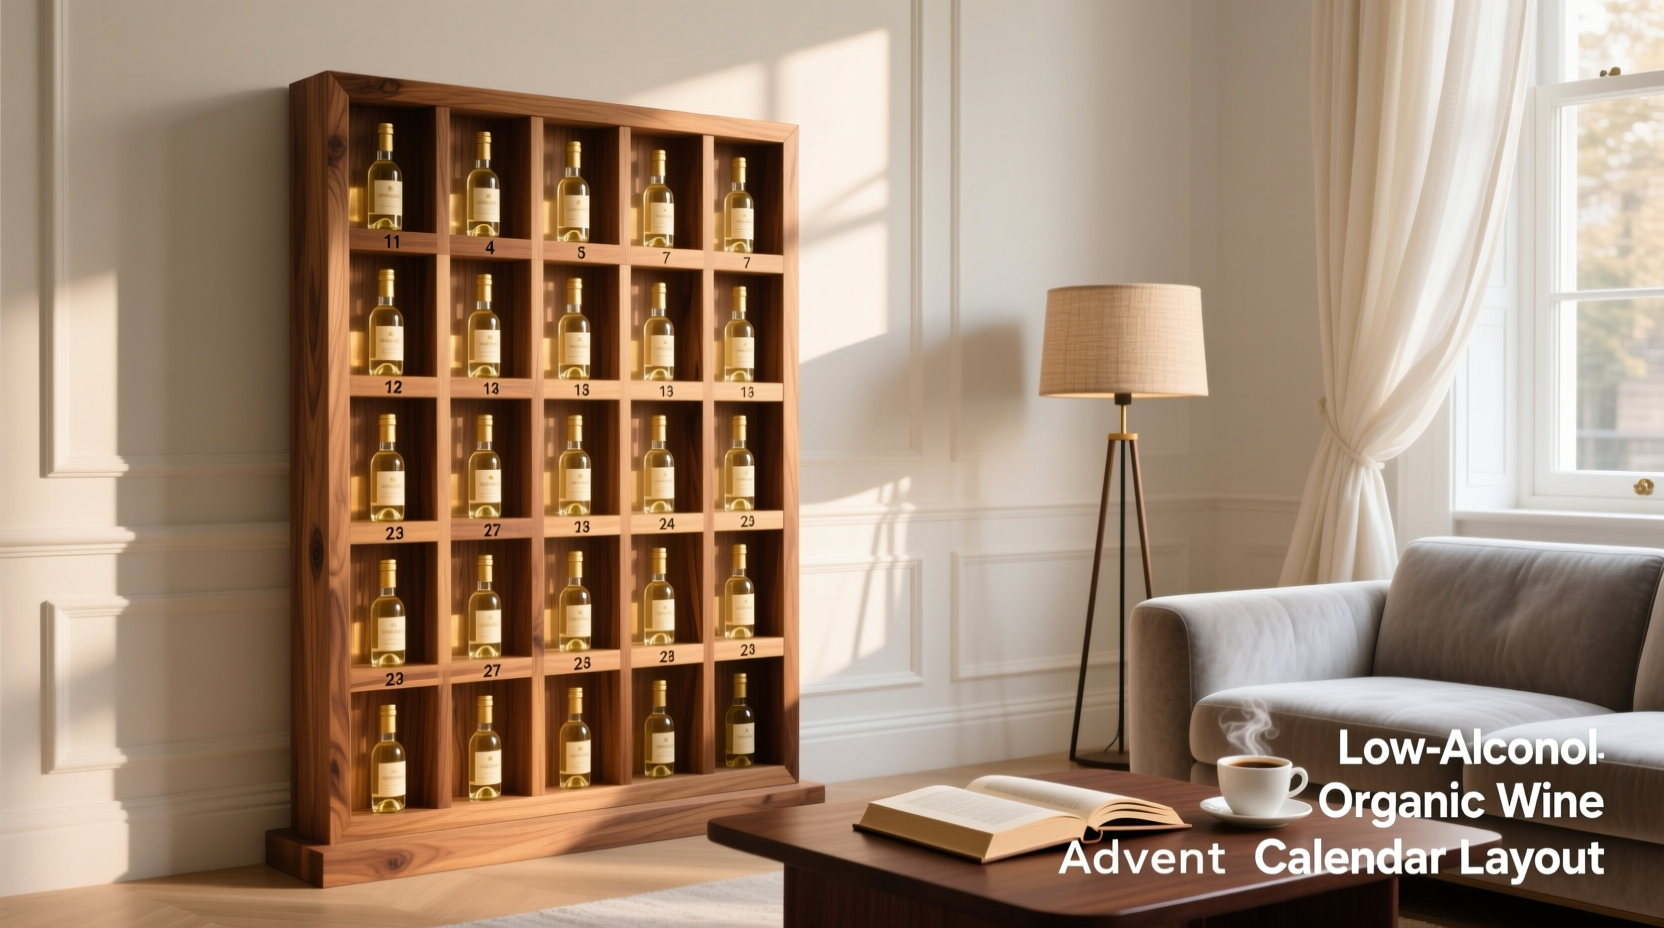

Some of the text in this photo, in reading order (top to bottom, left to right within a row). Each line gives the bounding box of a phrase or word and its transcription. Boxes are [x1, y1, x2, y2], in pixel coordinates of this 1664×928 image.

[383, 233, 400, 249] 11
[485, 240, 495, 255] 4
[662, 251, 671, 265] 7
[743, 256, 751, 269] 7
[384, 380, 403, 394] 12
[483, 523, 501, 537] 27
[659, 517, 675, 530] 24
[385, 526, 404, 540] 23
[483, 663, 501, 678] 27
